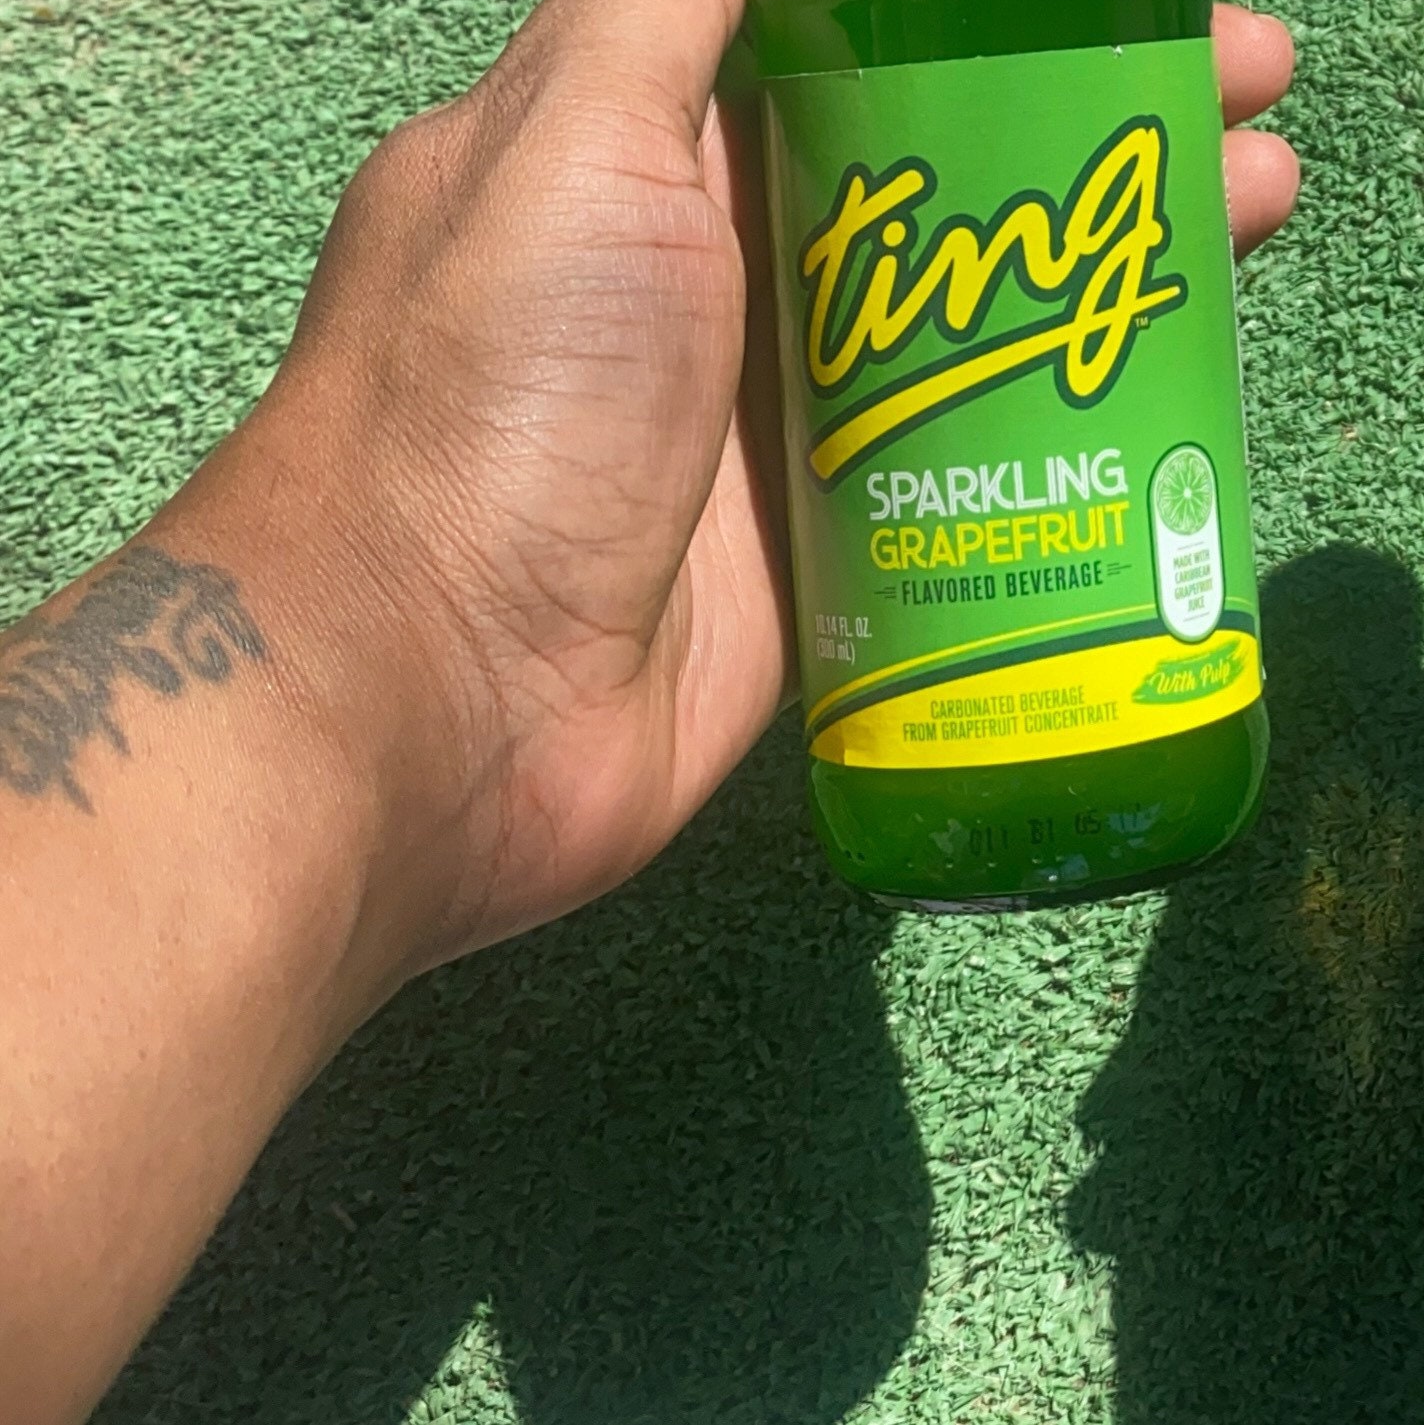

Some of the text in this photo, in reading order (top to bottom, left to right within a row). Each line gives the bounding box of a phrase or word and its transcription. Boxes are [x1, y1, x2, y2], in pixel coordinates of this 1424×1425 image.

[802, 114, 1186, 408] ting
[866, 448, 1129, 521] SPARKLING
[870, 501, 1130, 570] GRAPEFRUIT
[902, 560, 1103, 606] FLAVORED BEVERAGE
[1148, 659, 1231, 695] With Pulp
[903, 700, 1119, 742] FROM GRAPEFRUIT CONCENTRATE
[930, 685, 1084, 720] CARBONATED BEVERAGE
